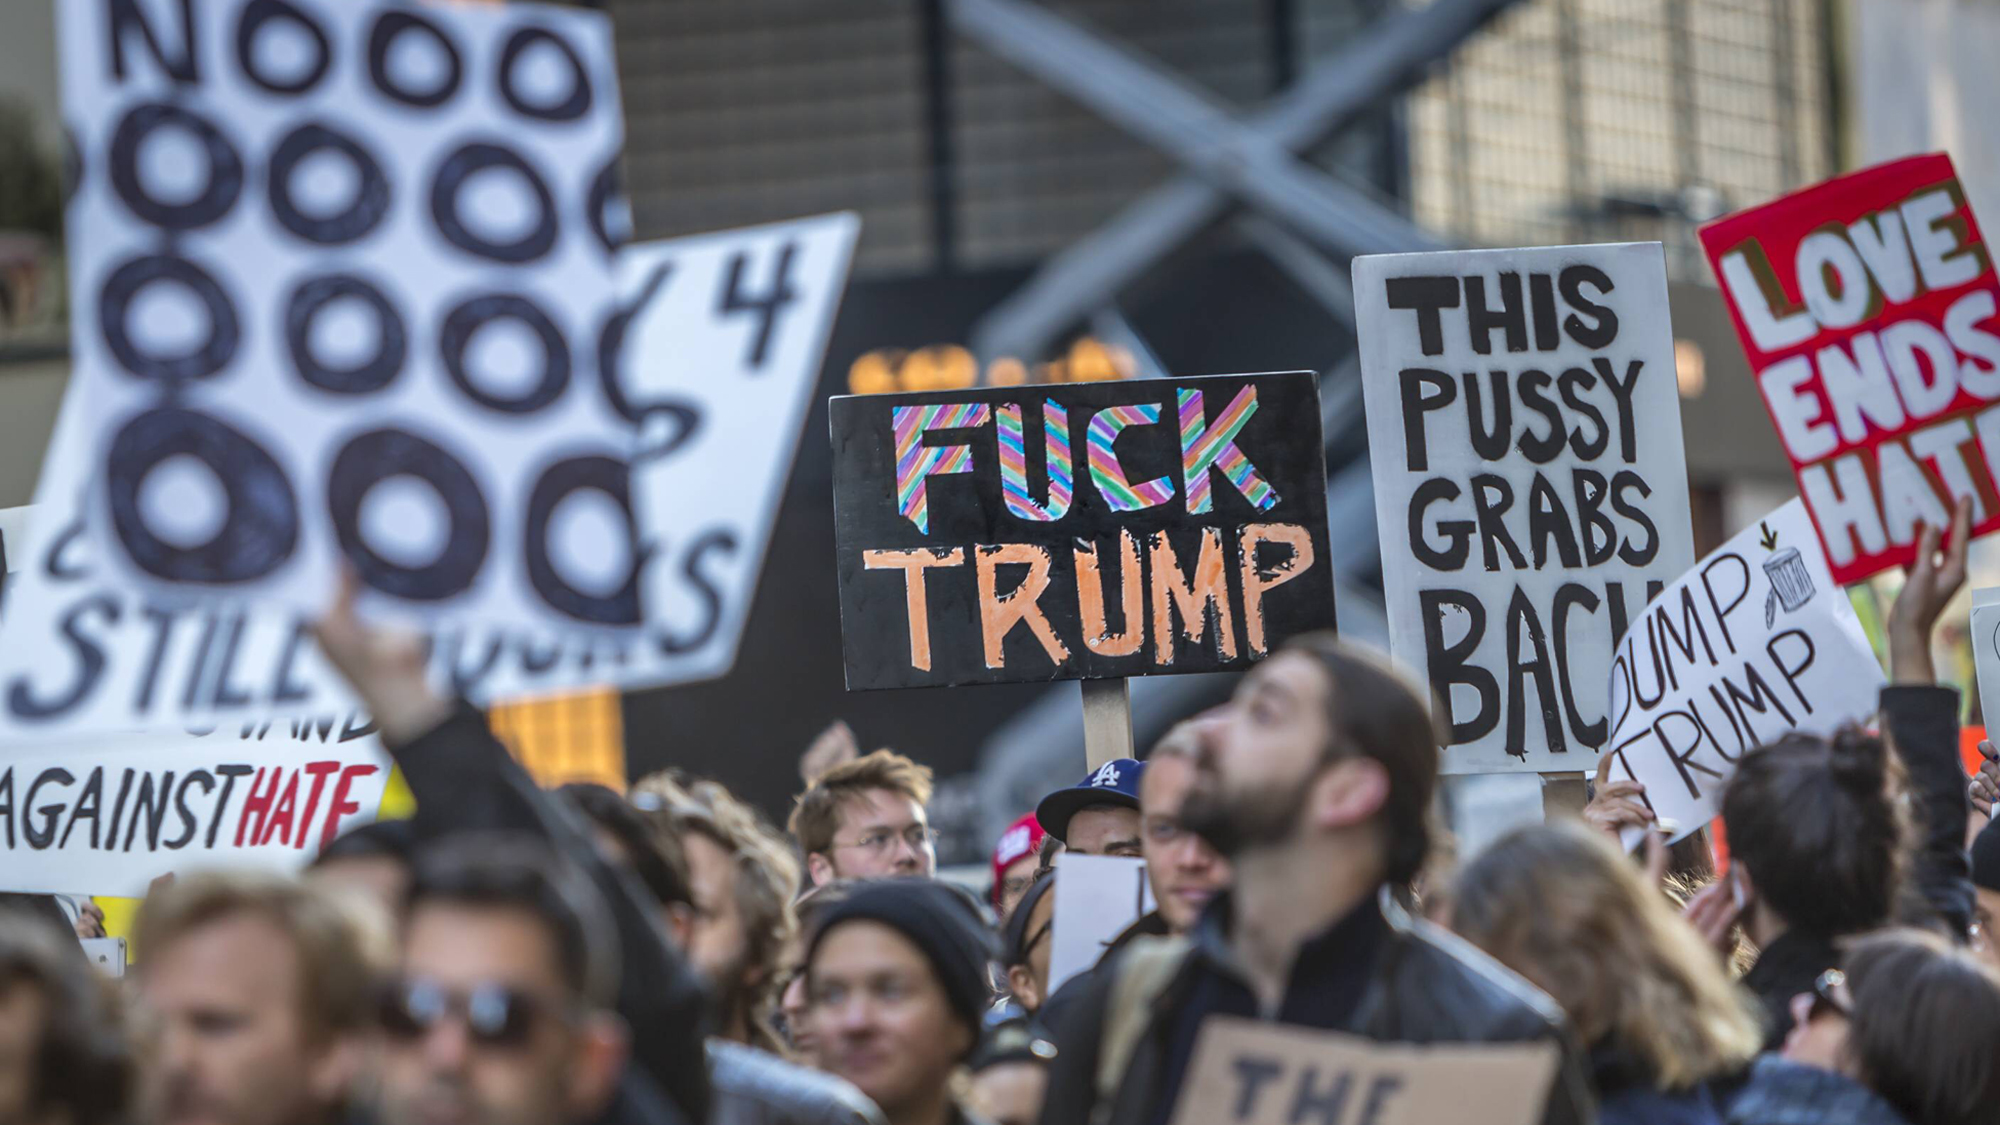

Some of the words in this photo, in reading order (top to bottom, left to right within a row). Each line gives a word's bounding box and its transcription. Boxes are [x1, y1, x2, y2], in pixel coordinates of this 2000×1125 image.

[1386, 265, 1618, 356] THIS
[1718, 182, 1986, 352] LOVE
[1399, 358, 1644, 472] PUSSY
[1759, 290, 2000, 464] ENDS
[892, 384, 1281, 535] FUCK
[1408, 468, 1660, 572] GRABS
[863, 522, 1314, 672] TRUMP
[1611, 552, 1751, 738] DUMP
[1091, 760, 1121, 788] LA
[1612, 629, 1816, 826] TRUMP
[233, 760, 380, 855] HATE
